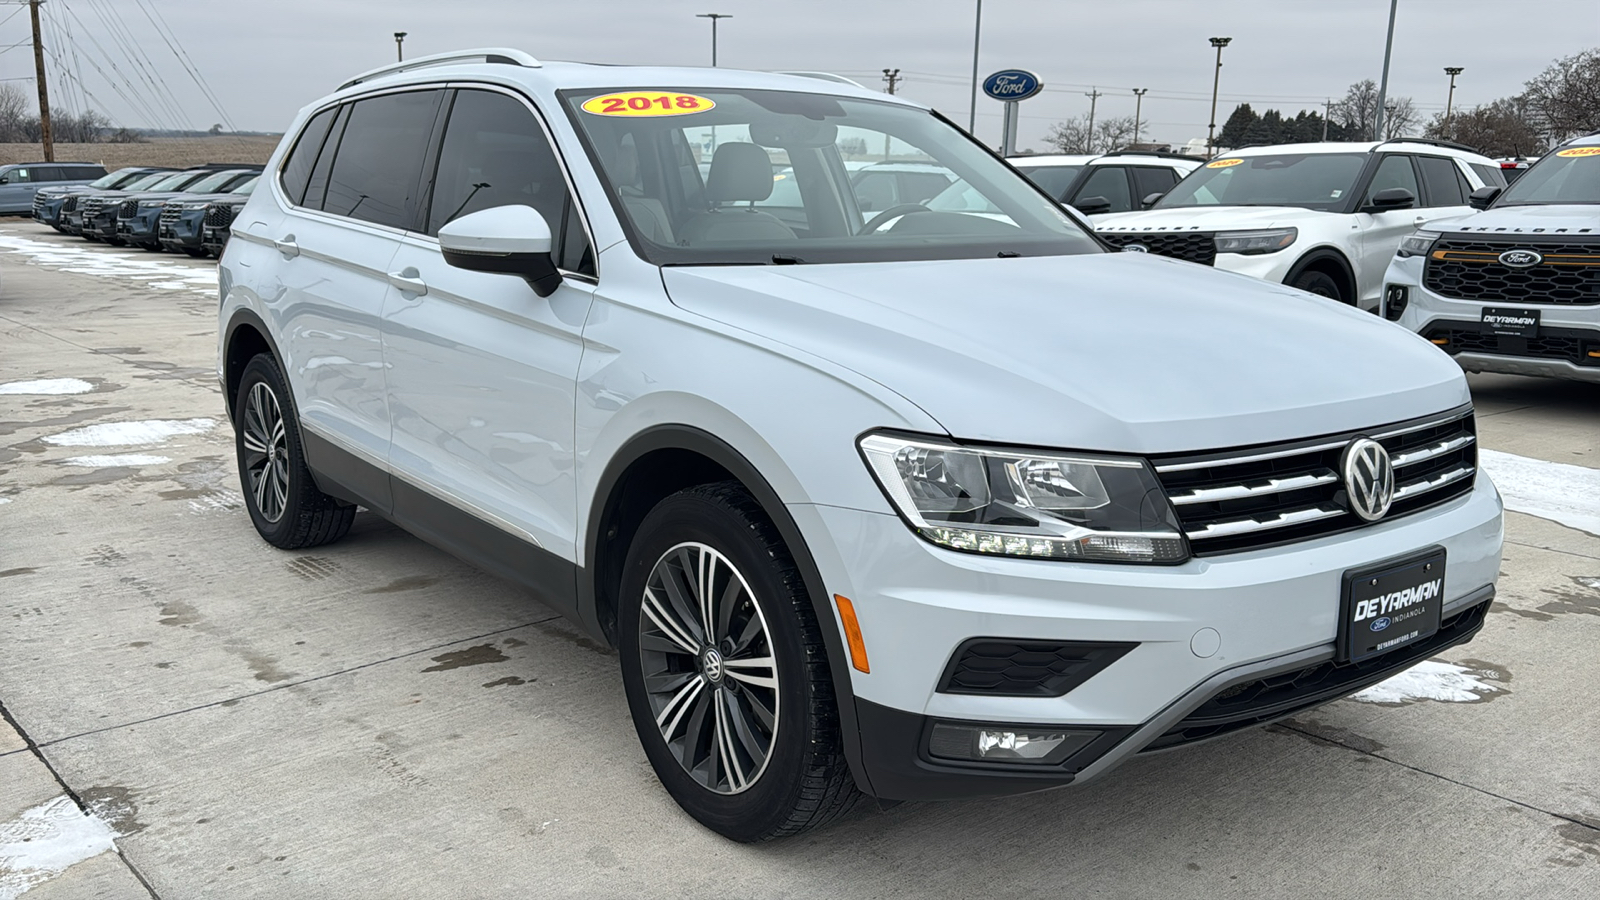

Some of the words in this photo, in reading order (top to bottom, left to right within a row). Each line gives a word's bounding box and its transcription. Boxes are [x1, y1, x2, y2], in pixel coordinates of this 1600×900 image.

[992, 75, 1026, 94] Ford
[601, 96, 700, 113] 2018
[1507, 252, 1531, 264] Ford
[1483, 315, 1535, 325] DEYARMAN
[1354, 578, 1441, 622] DEYARMAN
[1391, 606, 1426, 623] INDIANOLA
[1376, 630, 1418, 650] DEYARMANFORD.COM
